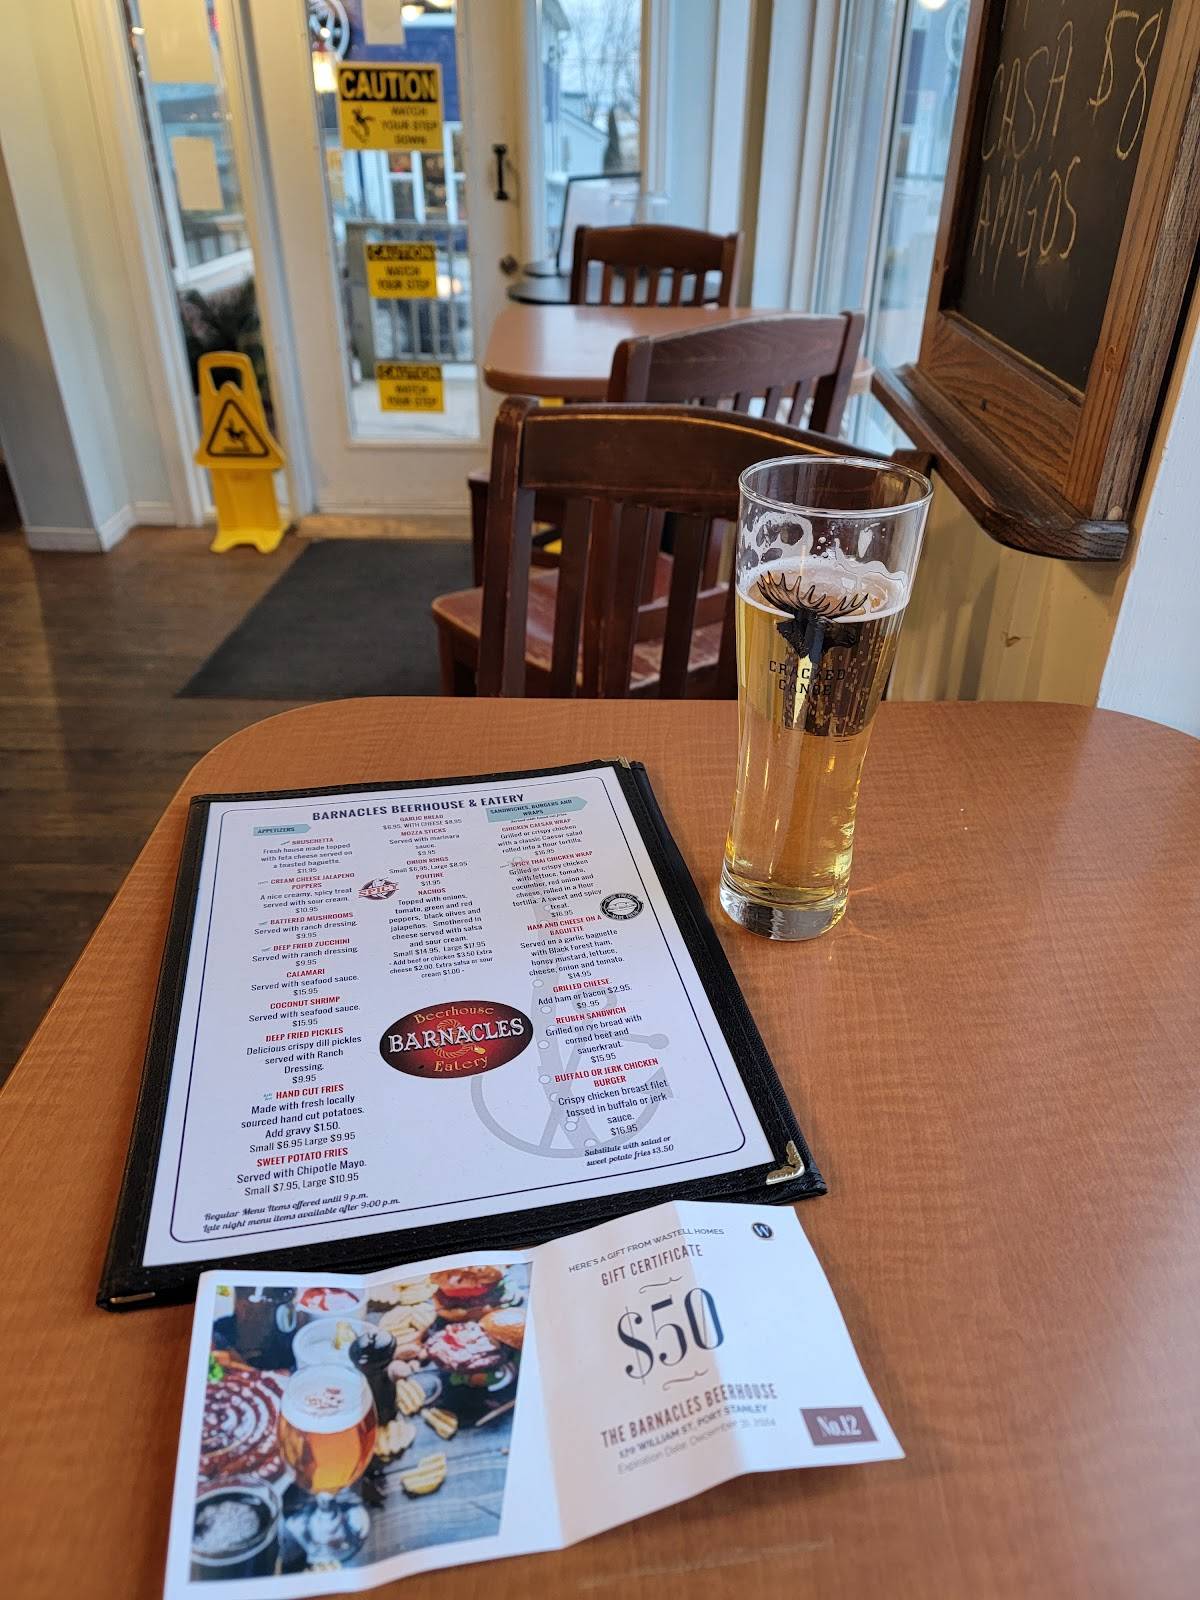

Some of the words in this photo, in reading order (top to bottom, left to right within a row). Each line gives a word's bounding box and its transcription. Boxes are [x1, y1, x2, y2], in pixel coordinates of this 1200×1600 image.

[339, 68, 437, 101] CAUTION
[981, 20, 1073, 161] CASH
[769, 660, 846, 681] CRACKED
[778, 679, 832, 696] CANOE
[312, 806, 387, 821] BARNACLES
[392, 800, 464, 814] BEERHOUSE
[469, 799, 477, 807] &
[481, 794, 524, 806] EATERY
[307, 912, 353, 921] MUSHROOMS
[273, 944, 291, 952] DEEP
[292, 942, 313, 950] FRIED
[314, 938, 350, 947] ZUCCHINI
[286, 969, 325, 978] CALAMARI
[552, 983, 582, 993] GRILLED
[583, 978, 610, 988] CHEESE
[270, 1000, 308, 1009] COCONUT
[310, 996, 340, 1005] SHRIMP
[538, 997, 553, 1005] Add
[554, 994, 572, 1003] ham
[583, 988, 607, 999] bacon
[248, 1013, 278, 1022] Served
[280, 1010, 298, 1018] with
[300, 1006, 333, 1016] seafood
[292, 1018, 318, 1027] $15.95
[414, 1006, 495, 1024] Beerhouse
[555, 1014, 586, 1024] REUBEN
[586, 1006, 627, 1019] SANDWICH
[266, 1034, 286, 1042] DEEP
[287, 1031, 310, 1040] FRIED
[311, 1027, 344, 1036] PICKLES
[388, 1018, 524, 1053] BARNACLES
[434, 1056, 488, 1072] Eatery
[590, 1053, 616, 1063] $15.95
[554, 1070, 590, 1083] BUFFALO
[591, 1068, 603, 1076] OR
[604, 1063, 623, 1074] JERK
[624, 1058, 659, 1071] CHICKEN
[276, 1090, 300, 1099] HAND
[302, 1087, 319, 1095] CUT
[321, 1084, 344, 1093] FRIES
[593, 1076, 627, 1088] BURGER
[558, 1093, 585, 1106] Crispy
[587, 1088, 620, 1101] chicken
[621, 1083, 649, 1095] breast
[649, 1079, 669, 1089] filet
[251, 1104, 277, 1114] Made
[278, 1102, 299, 1112] with
[301, 1098, 324, 1109] fresh
[326, 1095, 356, 1106] locally
[241, 1117, 278, 1128] sourced
[280, 1114, 303, 1124] hand
[305, 1112, 320, 1120] cut
[322, 1106, 365, 1119] potatoes.
[265, 1129, 284, 1139] Add
[285, 1125, 311, 1137] gravy
[610, 1124, 638, 1136] $16.95
[249, 1143, 275, 1153] Small
[276, 1139, 303, 1149] $6.95
[304, 1136, 328, 1146] Large
[330, 1132, 356, 1143] $9.95
[584, 1142, 622, 1157] Substitute
[623, 1140, 640, 1150] with
[641, 1137, 663, 1147] salad
[256, 1156, 286, 1167] SWEET
[287, 1151, 322, 1163] POTATO
[324, 1148, 348, 1157] FRIES
[586, 1157, 608, 1167] sweet
[609, 1153, 633, 1164] potato
[634, 1150, 652, 1160] fries
[652, 1144, 674, 1155] $3.50
[236, 1171, 271, 1184] Served
[273, 1168, 295, 1178] with
[297, 1163, 337, 1177] Chipotle
[339, 1159, 367, 1172] Mayo.
[244, 1186, 270, 1197] Small
[302, 1178, 327, 1189] Large
[329, 1173, 359, 1184] $10.95
[203, 1223, 222, 1233] Late
[222, 1220, 246, 1231] night
[247, 1216, 271, 1226] menu
[273, 1213, 296, 1223] items
[297, 1207, 336, 1219] available
[338, 1203, 359, 1214] after
[361, 1200, 380, 1210] 9:00
[381, 1198, 401, 1208] p.m.
[204, 1210, 240, 1222] Regular
[242, 1206, 266, 1216] Menu
[268, 1202, 291, 1212] Items
[292, 1199, 321, 1210] offered
[322, 1196, 342, 1205] until
[350, 1192, 368, 1202] p.m.
[568, 1259, 599, 1273] HERE'S
[600, 1255, 607, 1263] A
[607, 1248, 625, 1260] GIFT
[627, 1240, 652, 1253] FROM
[653, 1229, 693, 1244] WASTELL
[694, 1228, 724, 1236] HOMES
[601, 1266, 626, 1286] GIFT
[630, 1244, 704, 1276] CERTIFICATE
[617, 1287, 724, 1385] $50
[600, 1429, 626, 1448] THE
[630, 1396, 702, 1438] BARNACLES
[704, 1383, 778, 1408] BEERHOUSE
[638, 1429, 680, 1451] WILLIAM
